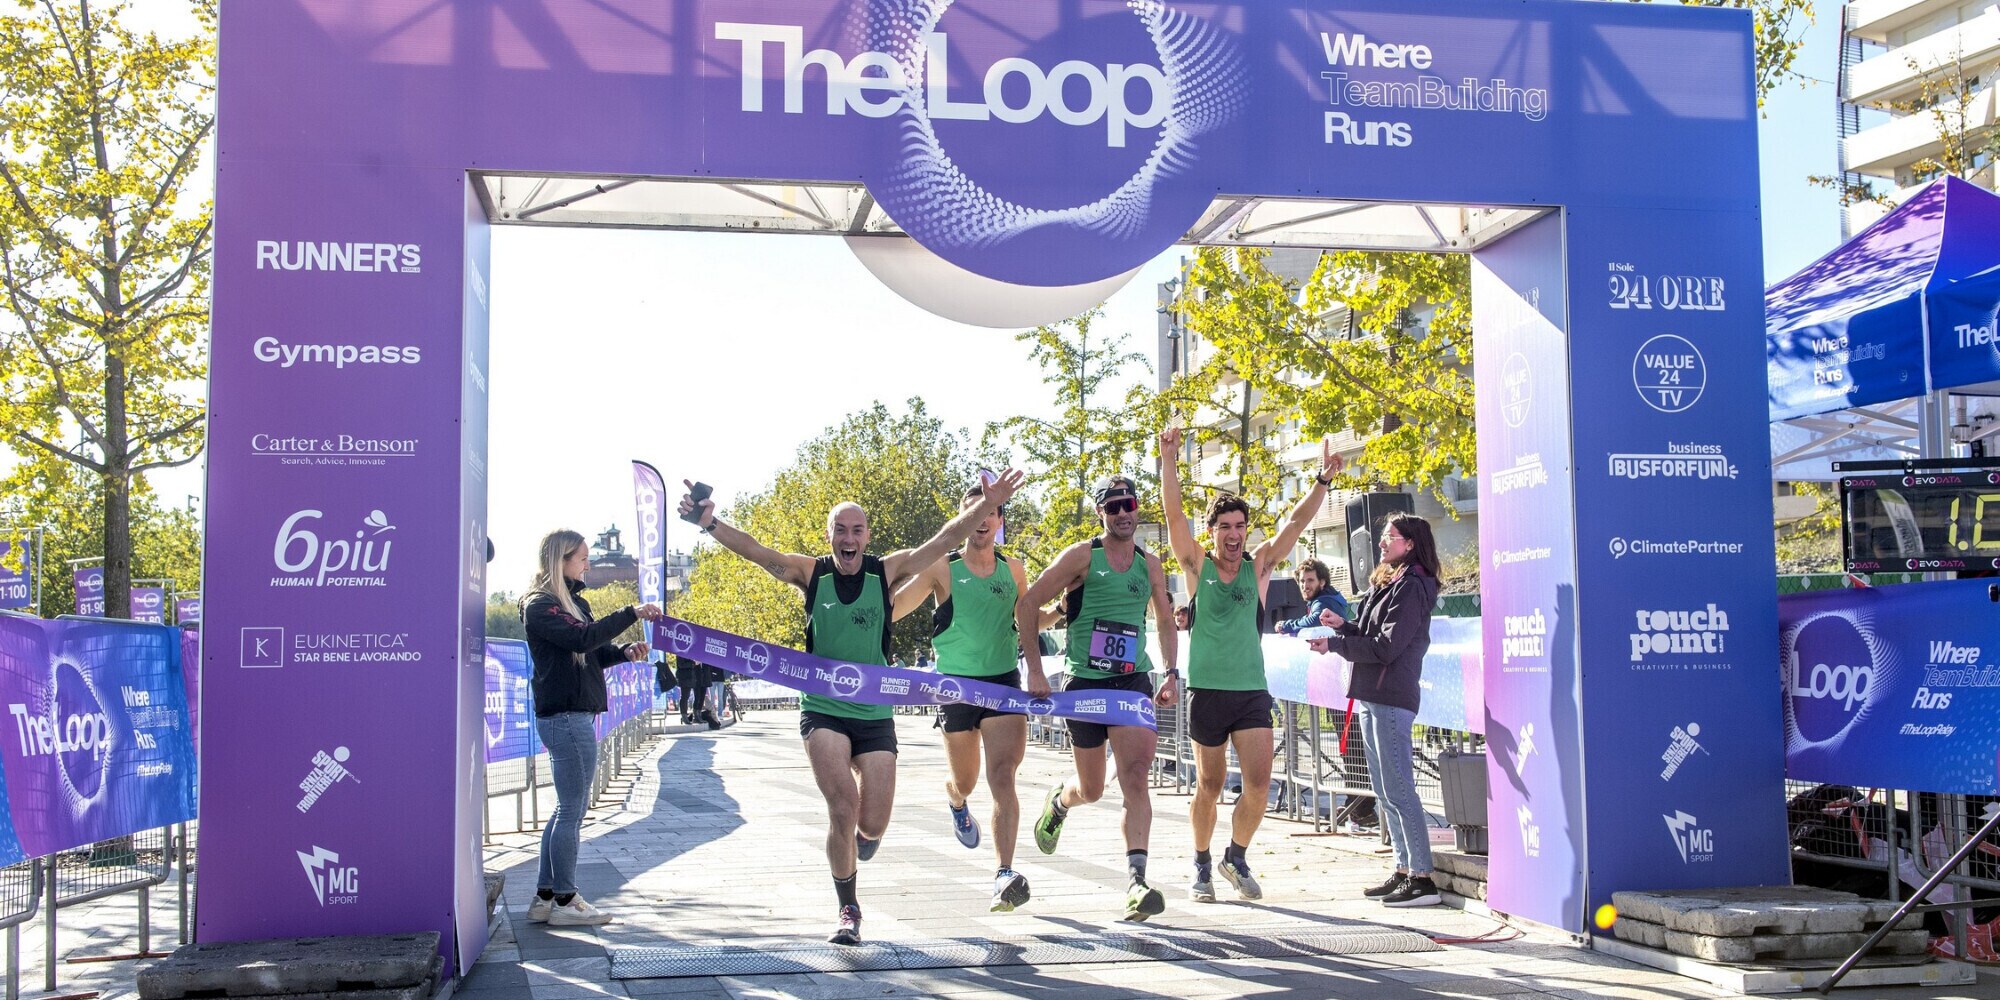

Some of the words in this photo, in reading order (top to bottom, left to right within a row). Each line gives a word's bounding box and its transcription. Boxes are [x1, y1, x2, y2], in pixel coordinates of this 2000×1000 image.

[1321, 32, 1432, 69] Where
[1321, 72, 1547, 121] TeamBuilding
[1324, 111, 1412, 147] Runs
[257, 240, 421, 273] RUNNER'S
[1616, 262, 1634, 271] Sole
[1608, 275, 1652, 309] 24
[1655, 275, 1725, 310] ORE
[253, 336, 421, 369] Gympass
[1812, 336, 1848, 354] Where
[1644, 355, 1694, 369] VALUE
[1659, 370, 1680, 385] 24
[1814, 369, 1843, 385] Runs
[1658, 390, 1682, 406] TV
[251, 434, 318, 451] Carter
[321, 440, 334, 451] &
[1668, 442, 1721, 454] business
[281, 457, 313, 465] Search,
[315, 457, 347, 465] Advice,
[1915, 476, 1962, 485] EVODATA
[1501, 547, 1551, 564] ClimatePartner
[1631, 540, 1743, 554] ClimatePartner
[1920, 560, 1966, 568] EVODATA
[270, 577, 314, 587] HUMAN
[326, 576, 387, 587] POTENTIAL
[1504, 608, 1546, 636] touch
[1636, 603, 1729, 631] touch
[294, 653, 320, 662] STAR
[323, 653, 350, 662] BENE
[354, 652, 421, 662] LAVORANDO
[706, 646, 727, 657] WORLD
[1104, 636, 1127, 659] 86
[1502, 635, 1541, 664] point
[1630, 632, 1717, 661] point
[1930, 640, 1980, 664] Where
[881, 686, 908, 694] WORLD
[1791, 651, 1874, 711] Loop
[121, 686, 149, 707] Where
[1911, 687, 1952, 709] Runs
[133, 729, 157, 749] Runs
[1669, 725, 1701, 755] SPORT
[311, 750, 349, 783] SPORT
[299, 767, 325, 793] SENZA
[296, 773, 335, 814] FRONTIERE
[1690, 829, 1713, 852] MG
[329, 867, 358, 893] MG
[329, 896, 358, 904] SPORT
